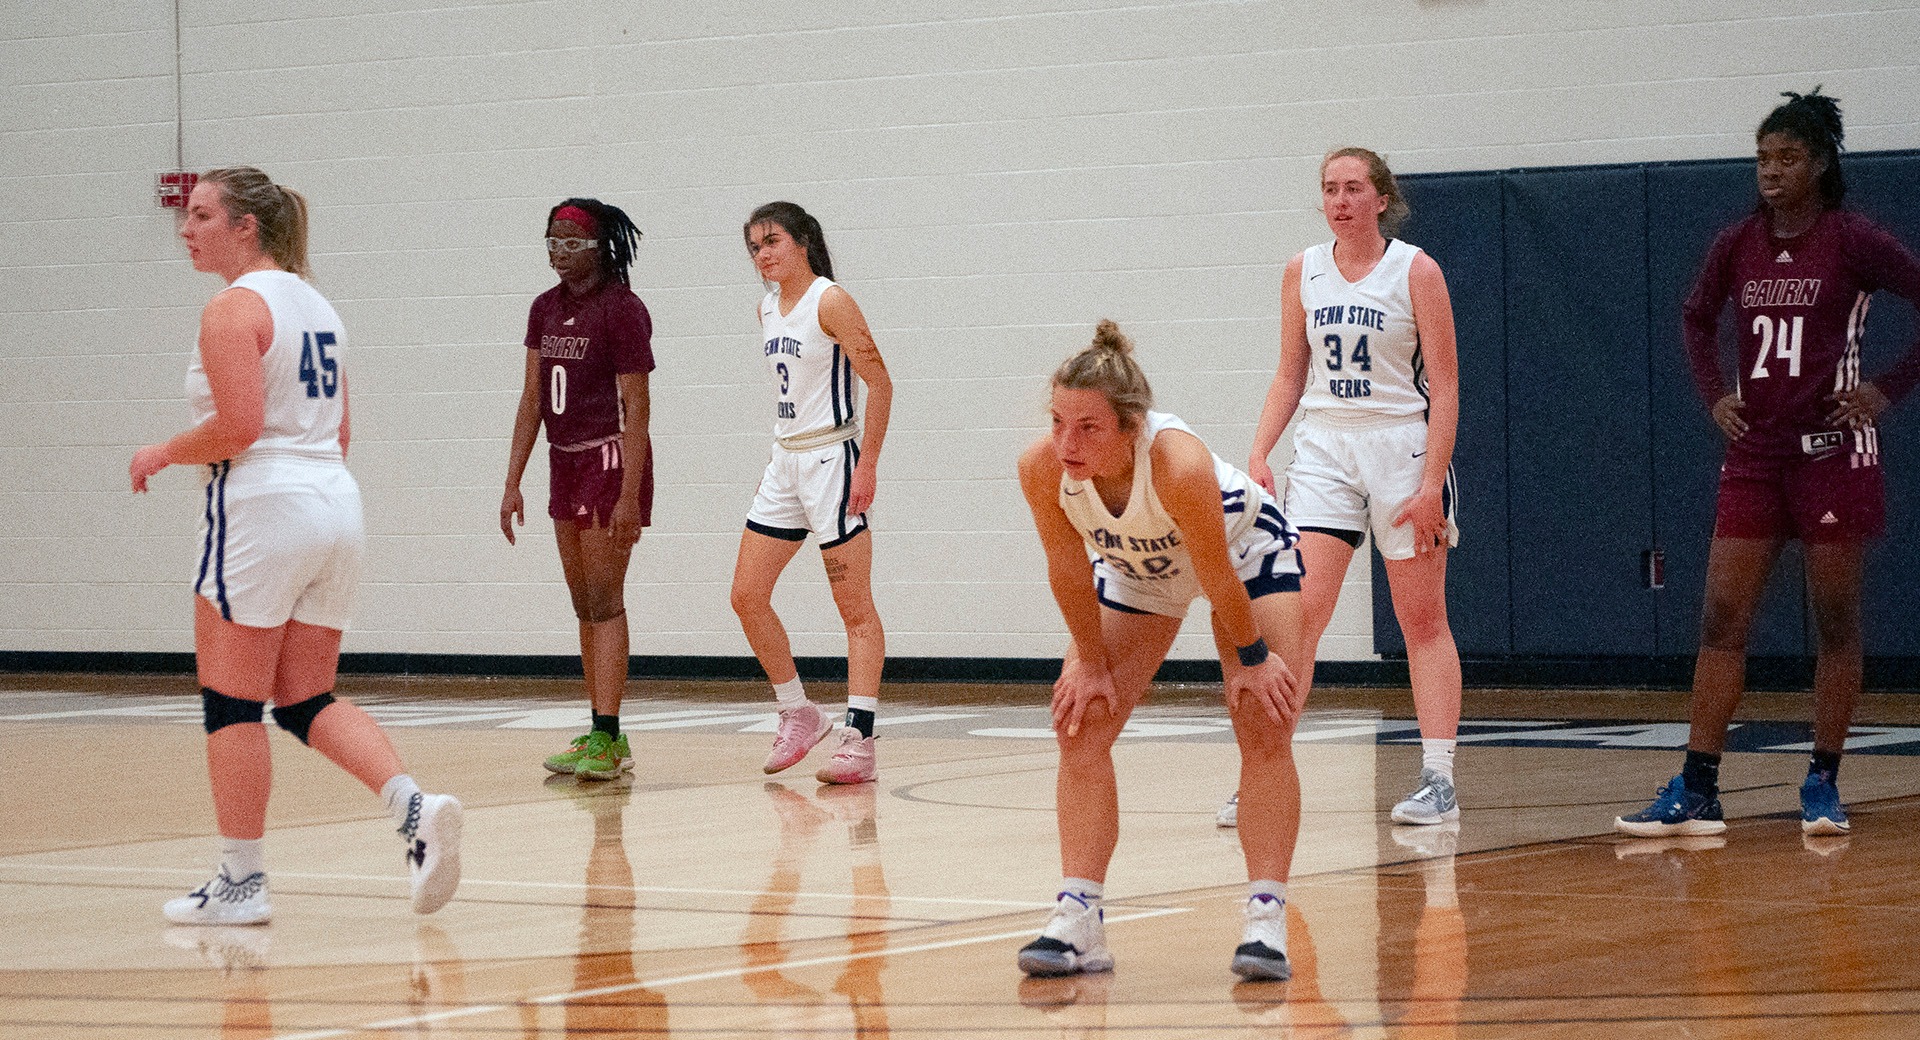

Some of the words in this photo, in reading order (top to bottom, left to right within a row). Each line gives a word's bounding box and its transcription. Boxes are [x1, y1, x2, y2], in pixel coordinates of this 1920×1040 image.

[1741, 278, 1821, 308] CAIRN
[1313, 305, 1344, 329] PENN
[1347, 305, 1385, 331] STATE
[781, 337, 802, 358] STATE
[1324, 334, 1371, 371] 34
[1750, 314, 1804, 379] 24
[299, 331, 337, 399] 45
[776, 362, 789, 395] 3
[551, 365, 566, 415] 0
[1330, 379, 1371, 398] BERKS
[1128, 530, 1180, 552] STATE
